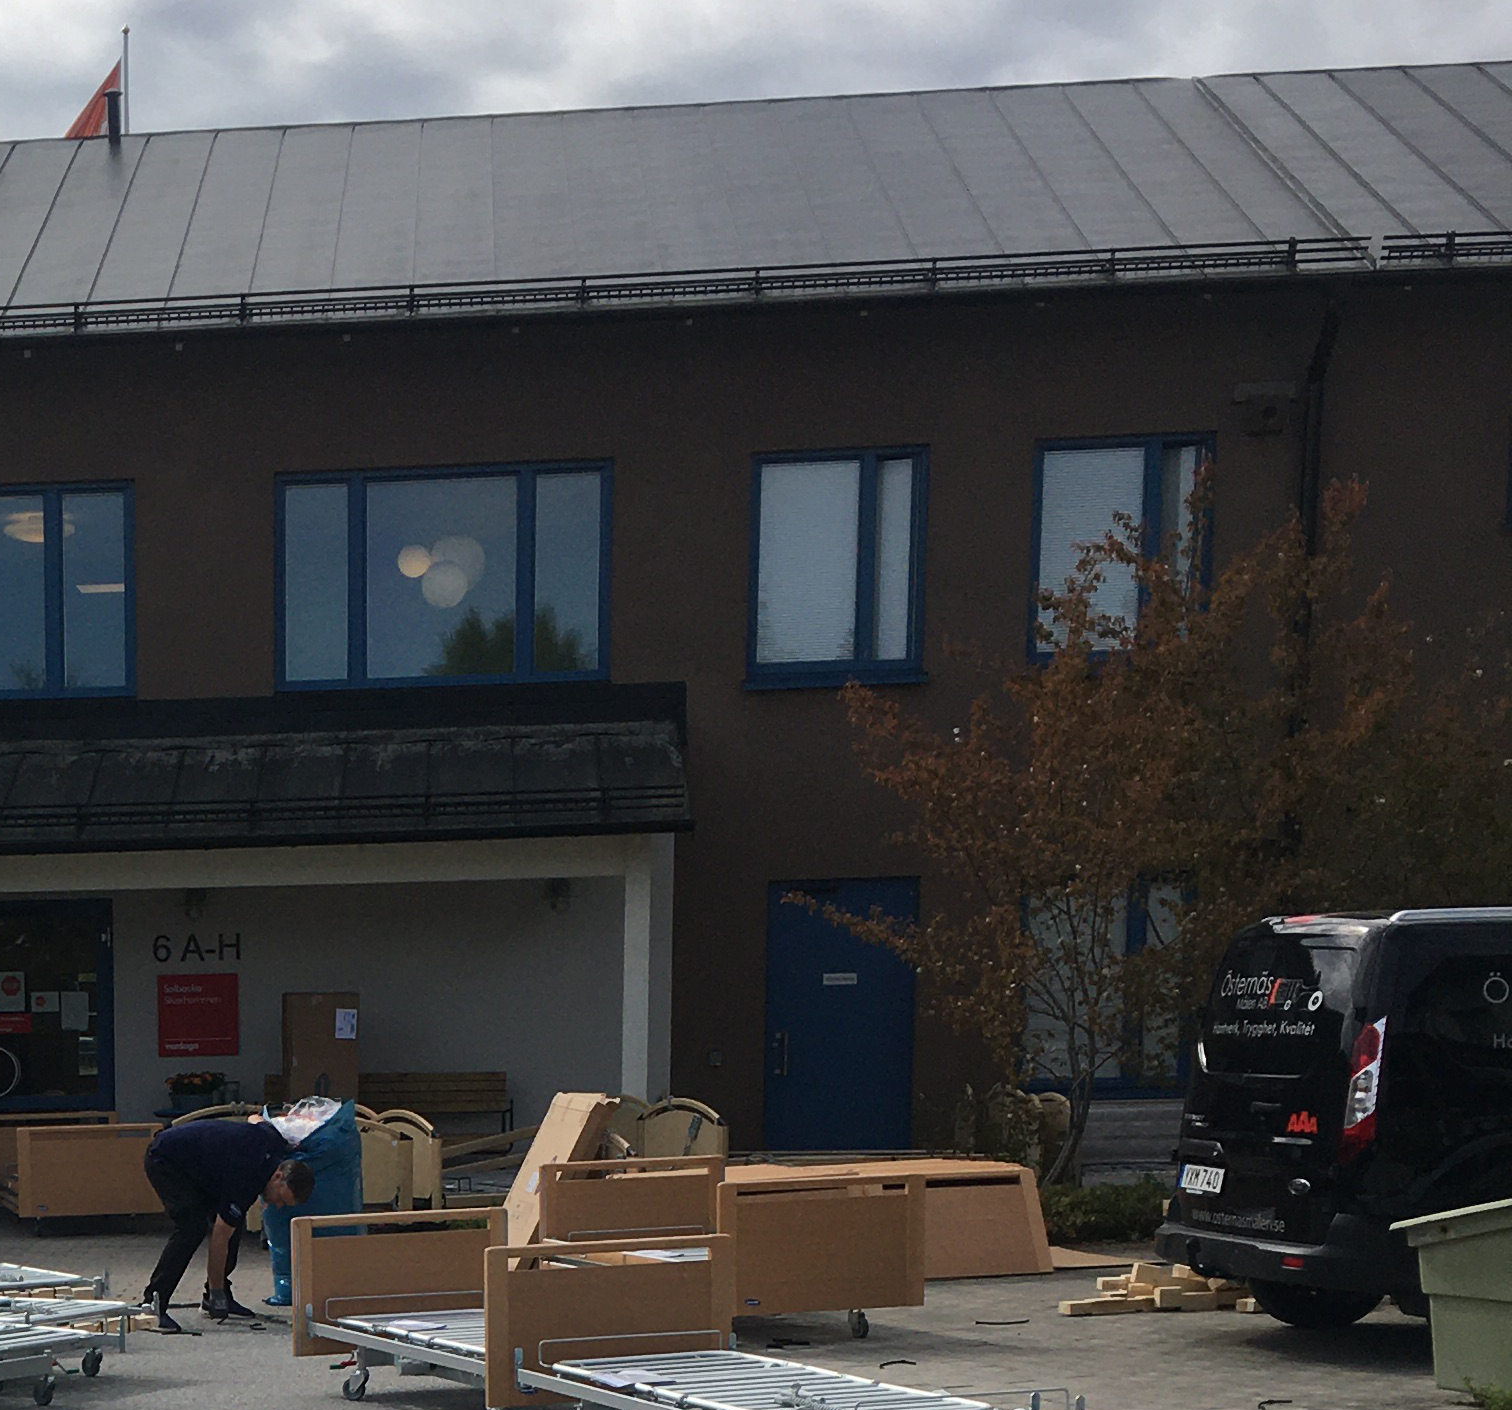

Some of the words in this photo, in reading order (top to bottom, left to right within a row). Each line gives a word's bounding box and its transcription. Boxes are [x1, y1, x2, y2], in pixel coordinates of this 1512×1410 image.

[152, 934, 172, 962] 6
[180, 932, 241, 962] A-H
[1221, 970, 1274, 997] Östernäs
[1286, 1111, 1318, 1134] AAA
[1200, 1168, 1220, 1190] 740
